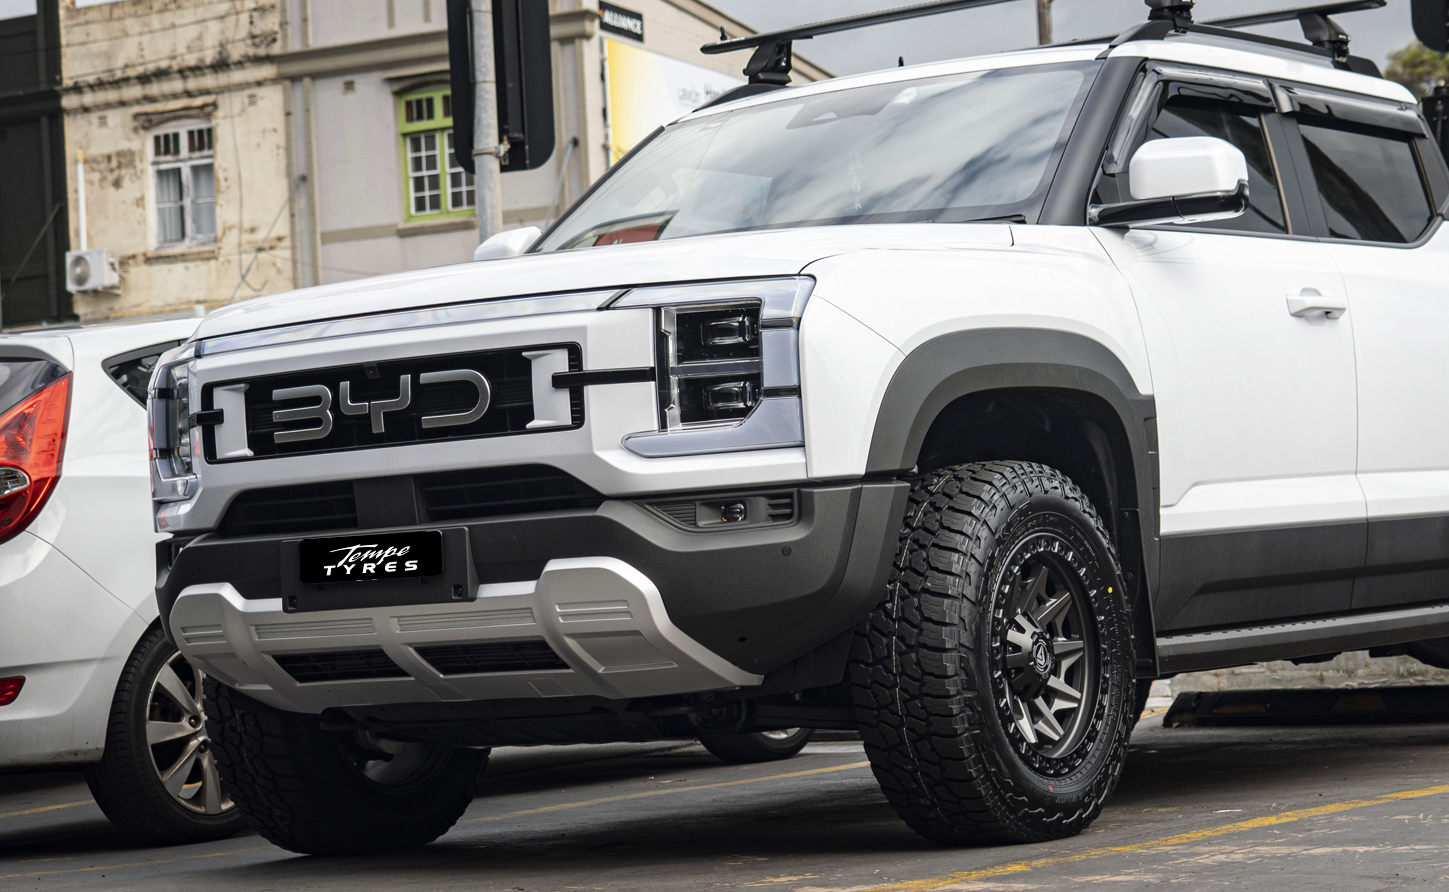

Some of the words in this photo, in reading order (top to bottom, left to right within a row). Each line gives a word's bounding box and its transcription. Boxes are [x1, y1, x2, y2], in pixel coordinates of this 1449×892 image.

[604, 9, 643, 35] ALLIANCE
[272, 369, 491, 444] BYD
[323, 560, 418, 576] TYRES
[329, 543, 411, 568] Tempe
